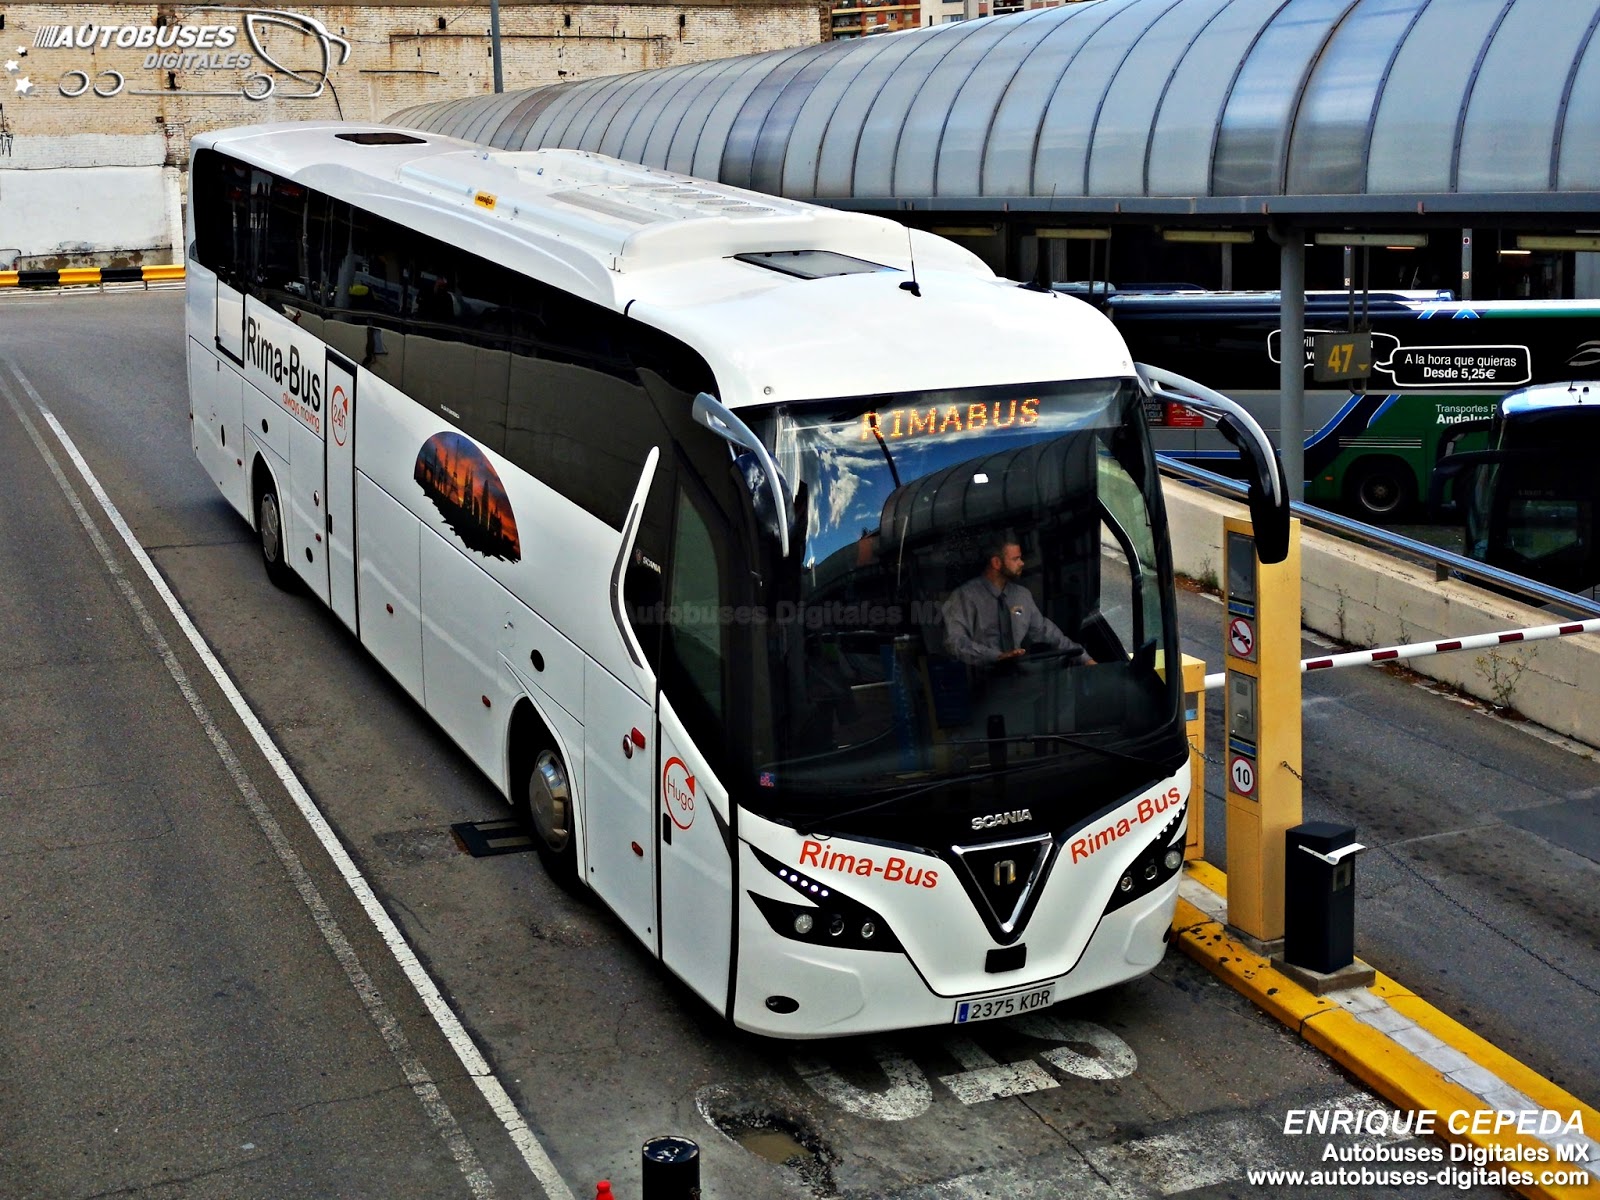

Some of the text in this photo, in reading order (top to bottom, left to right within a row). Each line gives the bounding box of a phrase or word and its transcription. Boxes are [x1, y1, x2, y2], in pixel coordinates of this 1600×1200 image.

[247, 315, 321, 413] Rima-Bus
[1328, 343, 1355, 373] 47
[1404, 353, 1517, 368] A la hora que quieras
[1423, 367, 1497, 381] Desde 5,25€
[282, 391, 320, 433] always moving
[333, 404, 346, 430] 24h
[861, 398, 1041, 440] RIMABUS
[1435, 404, 1488, 414] Transportes
[1235, 766, 1250, 786] 10
[667, 774, 695, 812] Hugo
[971, 808, 1033, 831] SCANIA
[1070, 786, 1181, 865] Rima-Bus
[799, 839, 939, 889] Rima-Bus
[970, 989, 1051, 1020] 2375 KDR
